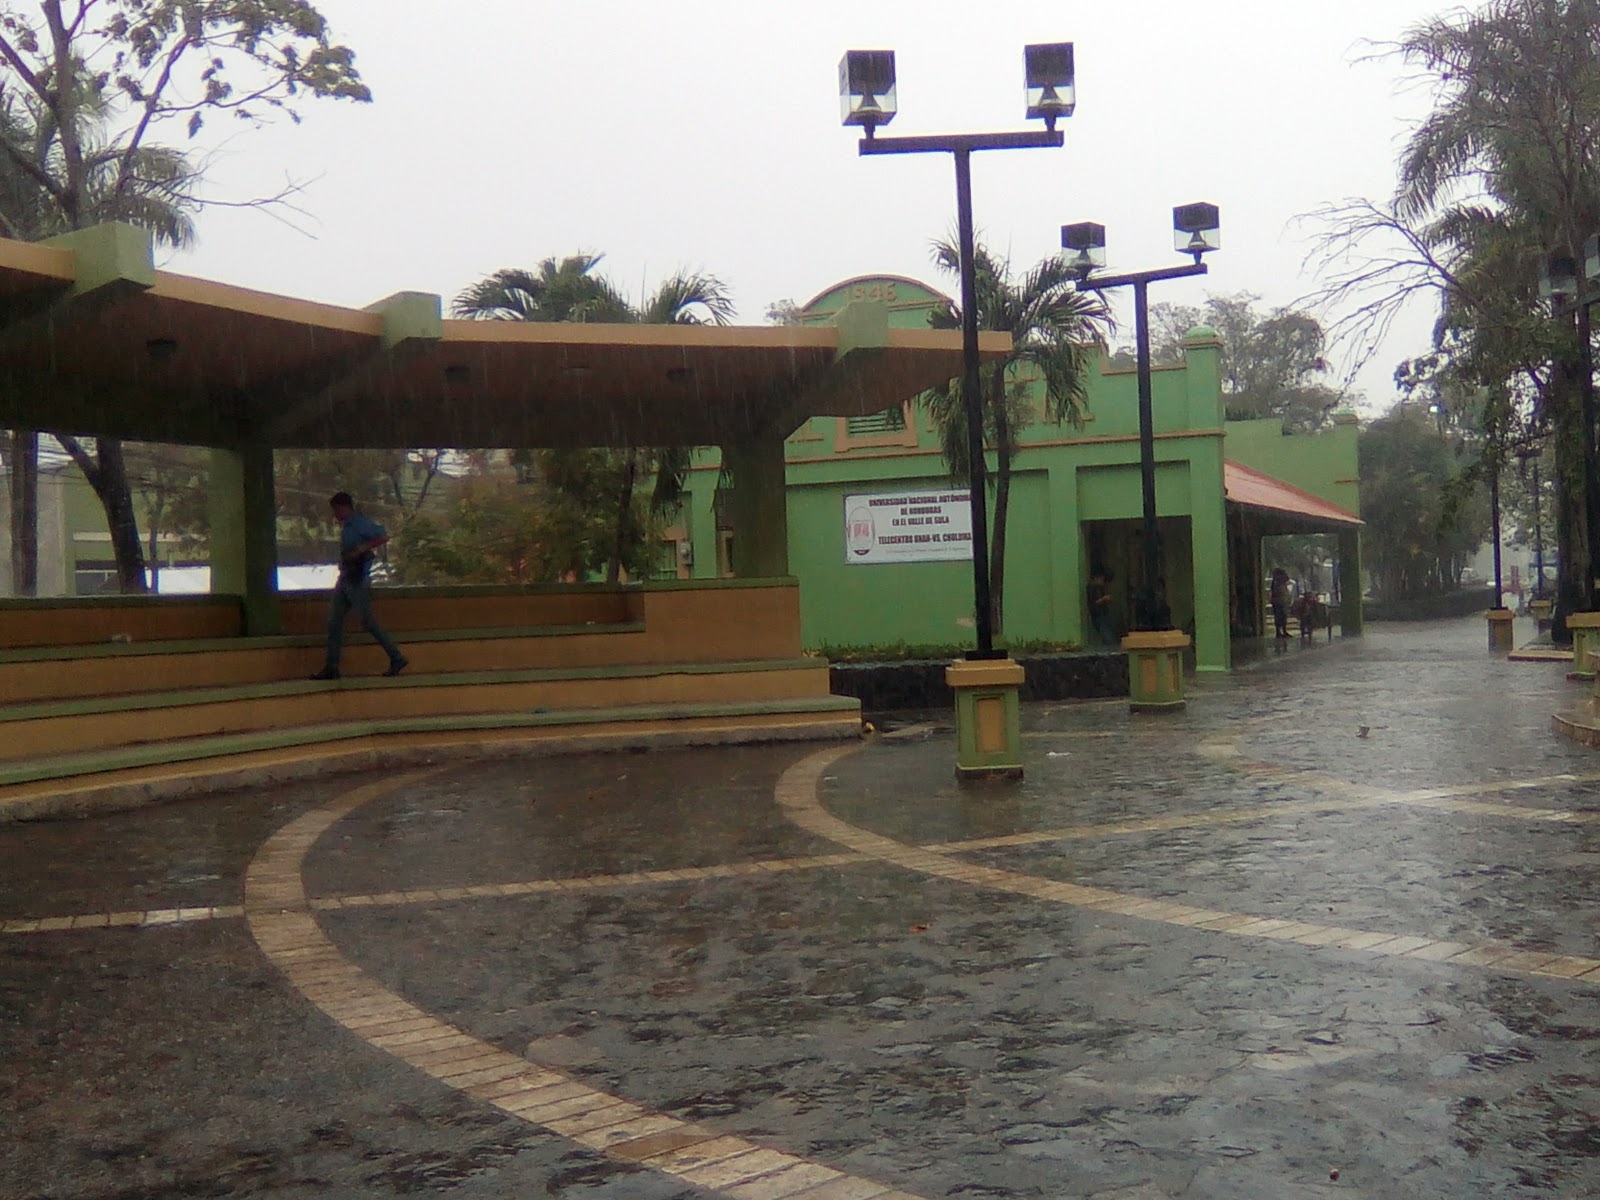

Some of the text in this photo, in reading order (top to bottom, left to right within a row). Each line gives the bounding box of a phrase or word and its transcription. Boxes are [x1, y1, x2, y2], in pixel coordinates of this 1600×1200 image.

[869, 498, 907, 507] UNIVERSIDAD
[908, 495, 937, 504] NACIONAL
[909, 506, 941, 515] HONDURAS
[892, 518, 899, 526] EN
[908, 517, 924, 525] VALLE
[934, 516, 949, 524] SULA
